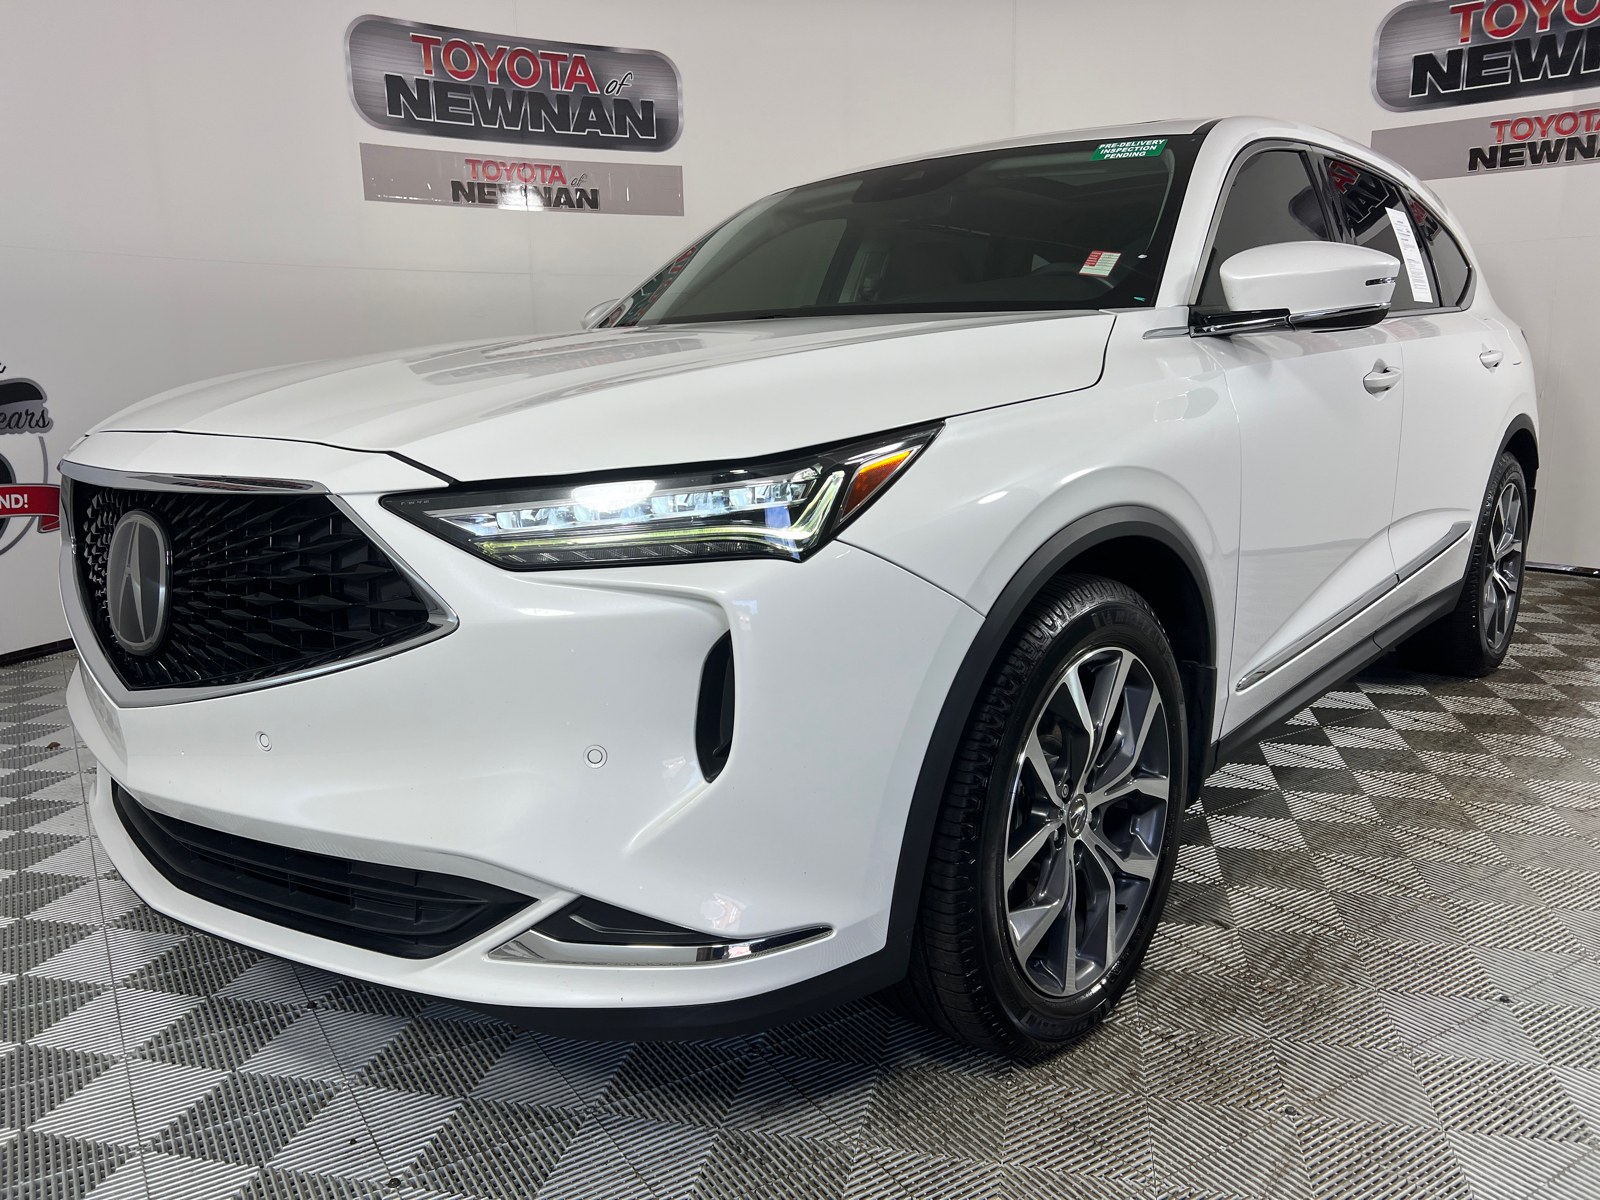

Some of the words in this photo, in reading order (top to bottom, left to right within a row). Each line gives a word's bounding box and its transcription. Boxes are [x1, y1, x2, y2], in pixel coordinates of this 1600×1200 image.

[409, 32, 601, 95] TOYOTA
[603, 72, 634, 96] of
[384, 73, 657, 139] NEWNAN
[1099, 139, 1165, 149] PRE-DELIVERY
[1100, 145, 1157, 154] INSPECTION
[1104, 151, 1146, 159] PENDING
[1467, 134, 1600, 173] NEWN
[464, 158, 568, 186] TOYOTA
[570, 173, 588, 188] of
